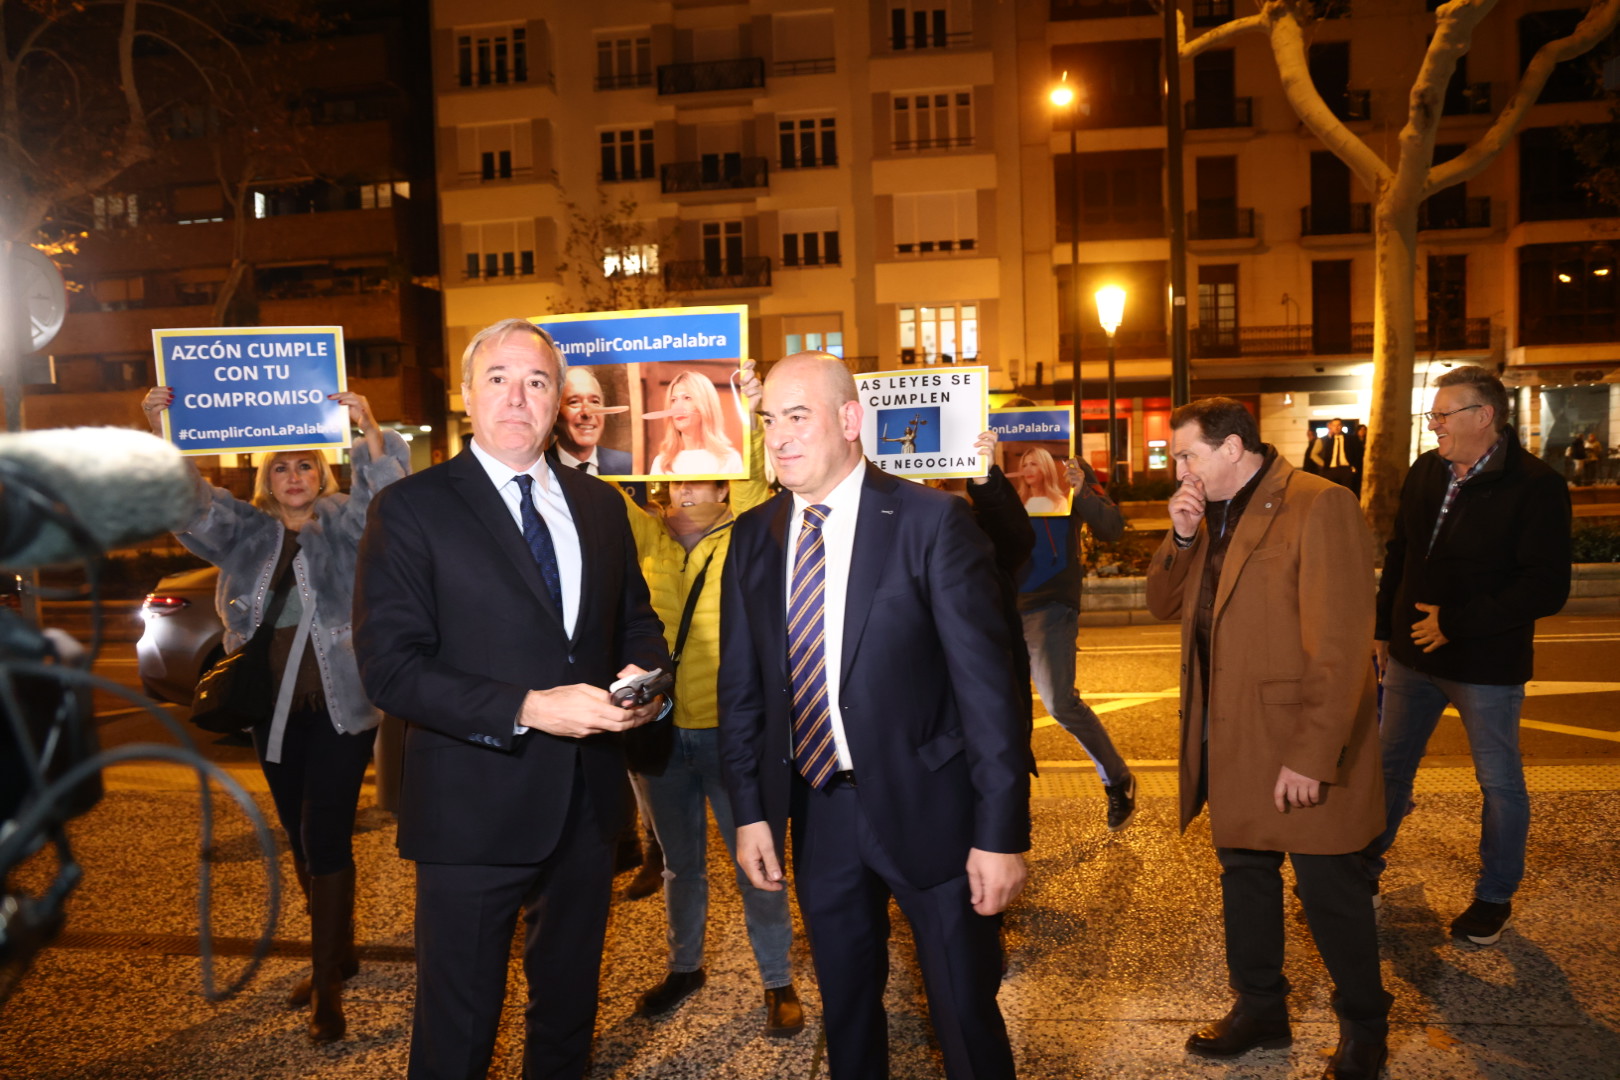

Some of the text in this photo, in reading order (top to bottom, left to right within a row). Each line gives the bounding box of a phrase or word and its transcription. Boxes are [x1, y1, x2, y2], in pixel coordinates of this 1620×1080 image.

[171, 340, 328, 360] AZCÓN CUMPLE
[214, 364, 290, 382] CON TU
[889, 375, 941, 389] LEYES
[951, 374, 971, 385] SE
[184, 389, 323, 409] COMPROMISO
[869, 391, 950, 407] CUMPLEN
[894, 457, 976, 470] NEGOCIAN
